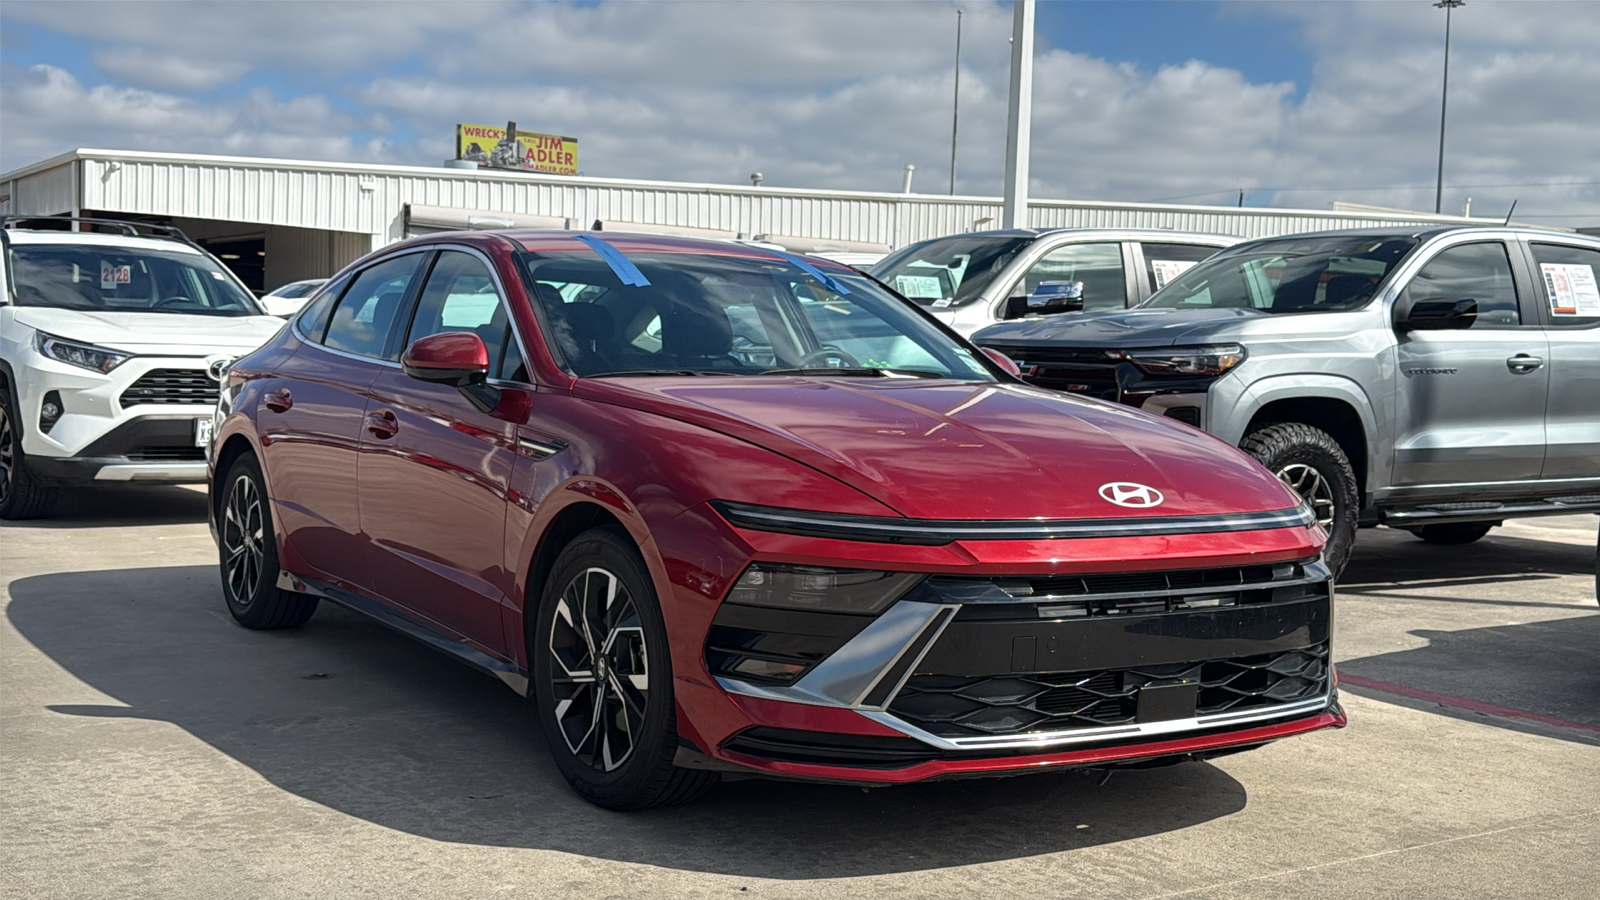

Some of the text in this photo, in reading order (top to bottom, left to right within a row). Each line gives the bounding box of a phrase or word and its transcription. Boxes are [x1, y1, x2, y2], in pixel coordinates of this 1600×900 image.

[464, 126, 506, 139] WRECK?
[536, 135, 563, 151] JIM
[525, 148, 573, 166] ADLER
[103, 268, 129, 282] 2128
